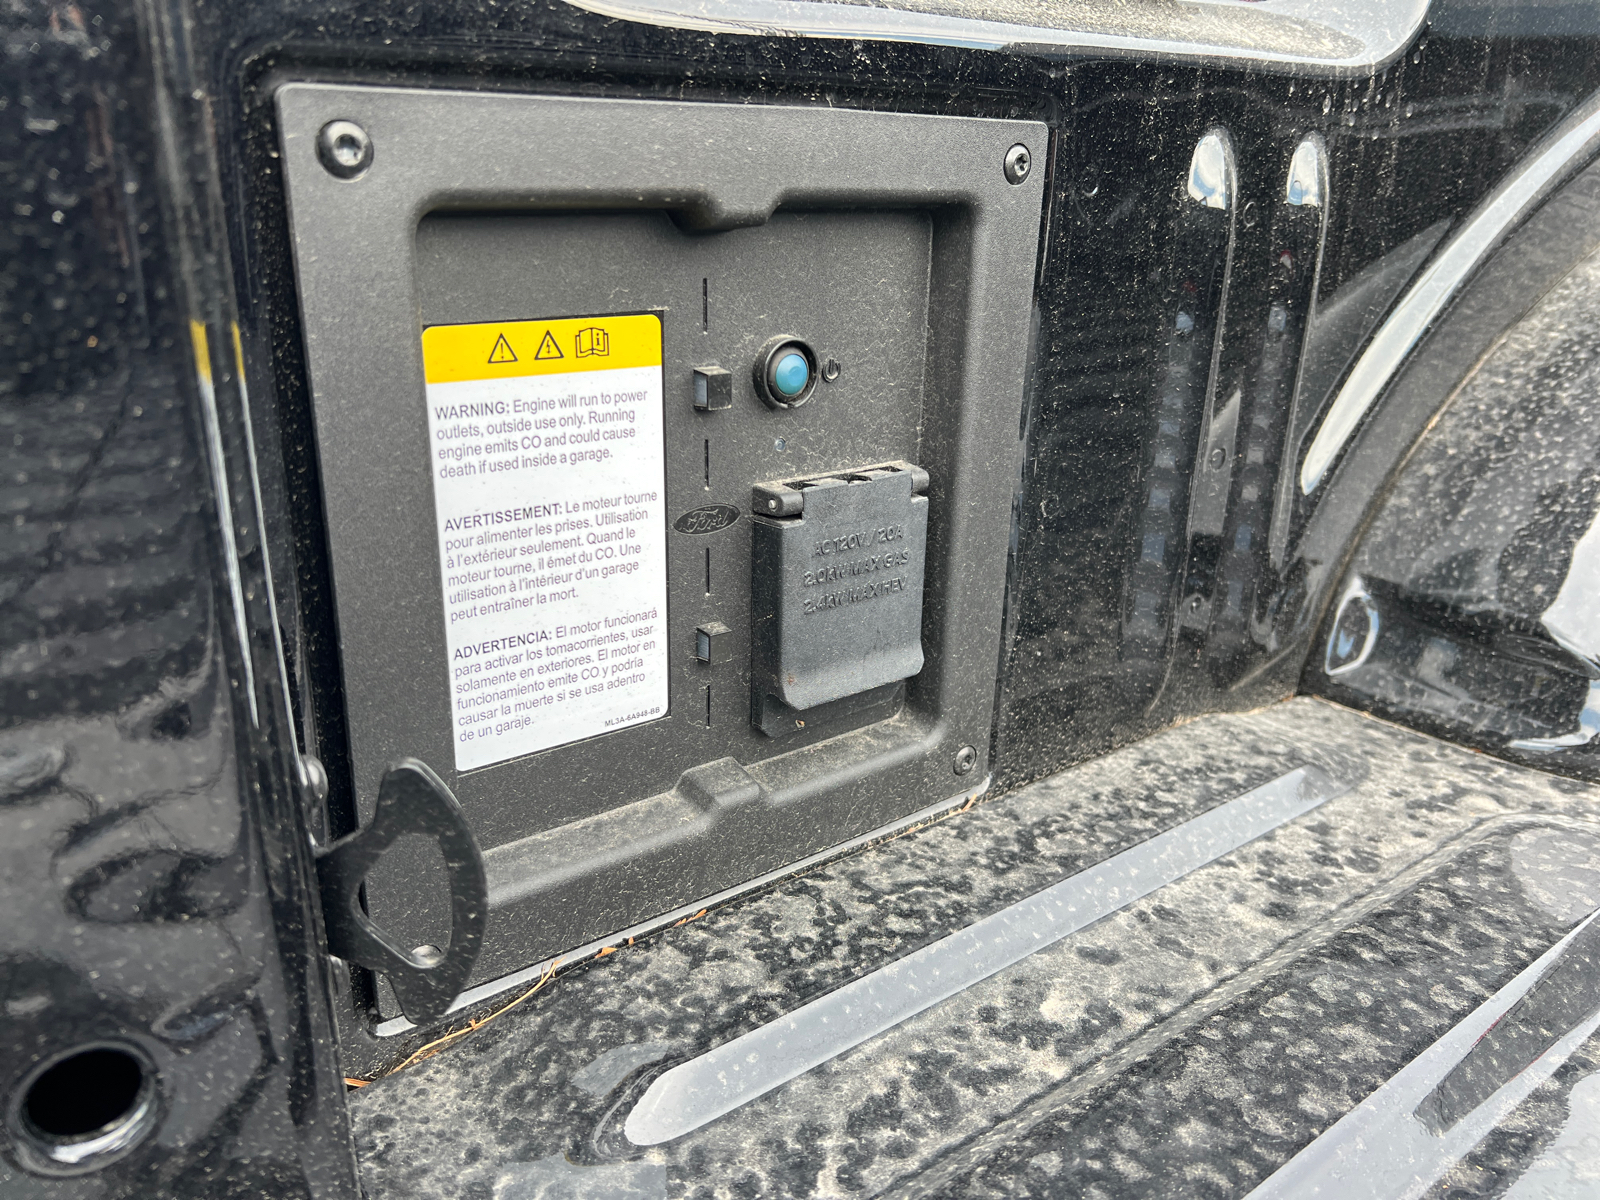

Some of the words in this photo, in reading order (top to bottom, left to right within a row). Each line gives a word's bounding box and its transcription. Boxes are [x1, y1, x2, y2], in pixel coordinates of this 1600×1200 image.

[434, 402, 510, 420] WARNING:
[513, 397, 556, 415] Engine
[558, 394, 577, 409] will
[579, 395, 598, 407] run
[600, 391, 611, 404] to
[614, 390, 648, 405] power
[437, 424, 484, 440] outlets,
[487, 419, 532, 435] outside
[535, 417, 556, 429] use
[559, 413, 586, 428] only.
[589, 408, 635, 424] Running
[438, 443, 482, 461] engine
[485, 437, 519, 454] emits
[521, 435, 541, 449] CO
[544, 432, 567, 447] and
[569, 427, 600, 444] could
[603, 427, 636, 440] cause
[440, 462, 476, 478] death
[479, 459, 487, 473] if
[489, 454, 519, 471] used
[522, 451, 557, 468] inside
[559, 452, 568, 463] a
[569, 447, 613, 465] garage.
[444, 503, 563, 532] AVERTISSEMENT:
[566, 501, 580, 513] Le
[582, 496, 622, 511] moteur
[624, 491, 658, 505] tourne
[445, 536, 474, 553] pour
[476, 526, 533, 545] alimenter
[535, 521, 552, 534] les
[555, 517, 593, 534] prises.
[595, 508, 648, 526] Utilisation
[683, 509, 729, 533] Ford
[447, 556, 455, 569] à
[458, 547, 517, 566] l'extérieur
[520, 535, 584, 556] seulement.
[586, 528, 624, 545] Quand
[626, 528, 636, 538] le
[811, 540, 830, 557] AC
[833, 532, 866, 553] 120V
[867, 529, 876, 547] /
[878, 525, 903, 543] 20A
[448, 569, 492, 586] moteur
[493, 560, 536, 578] tourne,
[538, 556, 544, 569] il
[547, 553, 577, 568] émet
[578, 550, 593, 563] du
[595, 546, 617, 560] CO.
[620, 542, 641, 556] Une
[851, 555, 881, 575] MAX
[883, 549, 910, 568] GAS
[449, 583, 506, 604] utilisation
[509, 580, 517, 592] à
[519, 570, 573, 591] l'intérieur
[575, 565, 599, 581] d'un
[601, 560, 639, 577] garage
[848, 583, 879, 602] MAX
[880, 576, 907, 594] HEV
[450, 605, 478, 623] peut
[480, 594, 534, 615] entraîner
[536, 591, 547, 604] la
[549, 587, 579, 602] mort.
[454, 630, 552, 660] ADVERTENCIA:
[556, 626, 567, 638] El
[570, 620, 602, 636] motor
[604, 608, 658, 629] funcionará
[455, 665, 482, 679] para
[485, 654, 524, 670] activar
[526, 649, 543, 660] los
[546, 633, 629, 657] tomacorrientes,
[631, 625, 653, 638] usar
[456, 672, 517, 693] solamente
[520, 668, 535, 678] en
[537, 655, 594, 675] exteriores.
[598, 649, 609, 661] El
[611, 643, 641, 658] motor
[643, 640, 656, 650] en
[457, 682, 545, 710] funcionamiento
[548, 672, 579, 688] emite
[581, 667, 599, 680] CO
[602, 666, 609, 678] y
[611, 658, 644, 676] podría
[458, 708, 498, 726] causar
[500, 703, 511, 715] la
[514, 696, 554, 713] muerte
[557, 692, 566, 703] si
[569, 688, 582, 698] se
[585, 683, 604, 695] usa
[607, 672, 645, 690] adentro
[460, 729, 475, 742] de
[478, 725, 493, 737] un
[496, 718, 535, 735] garaje.
